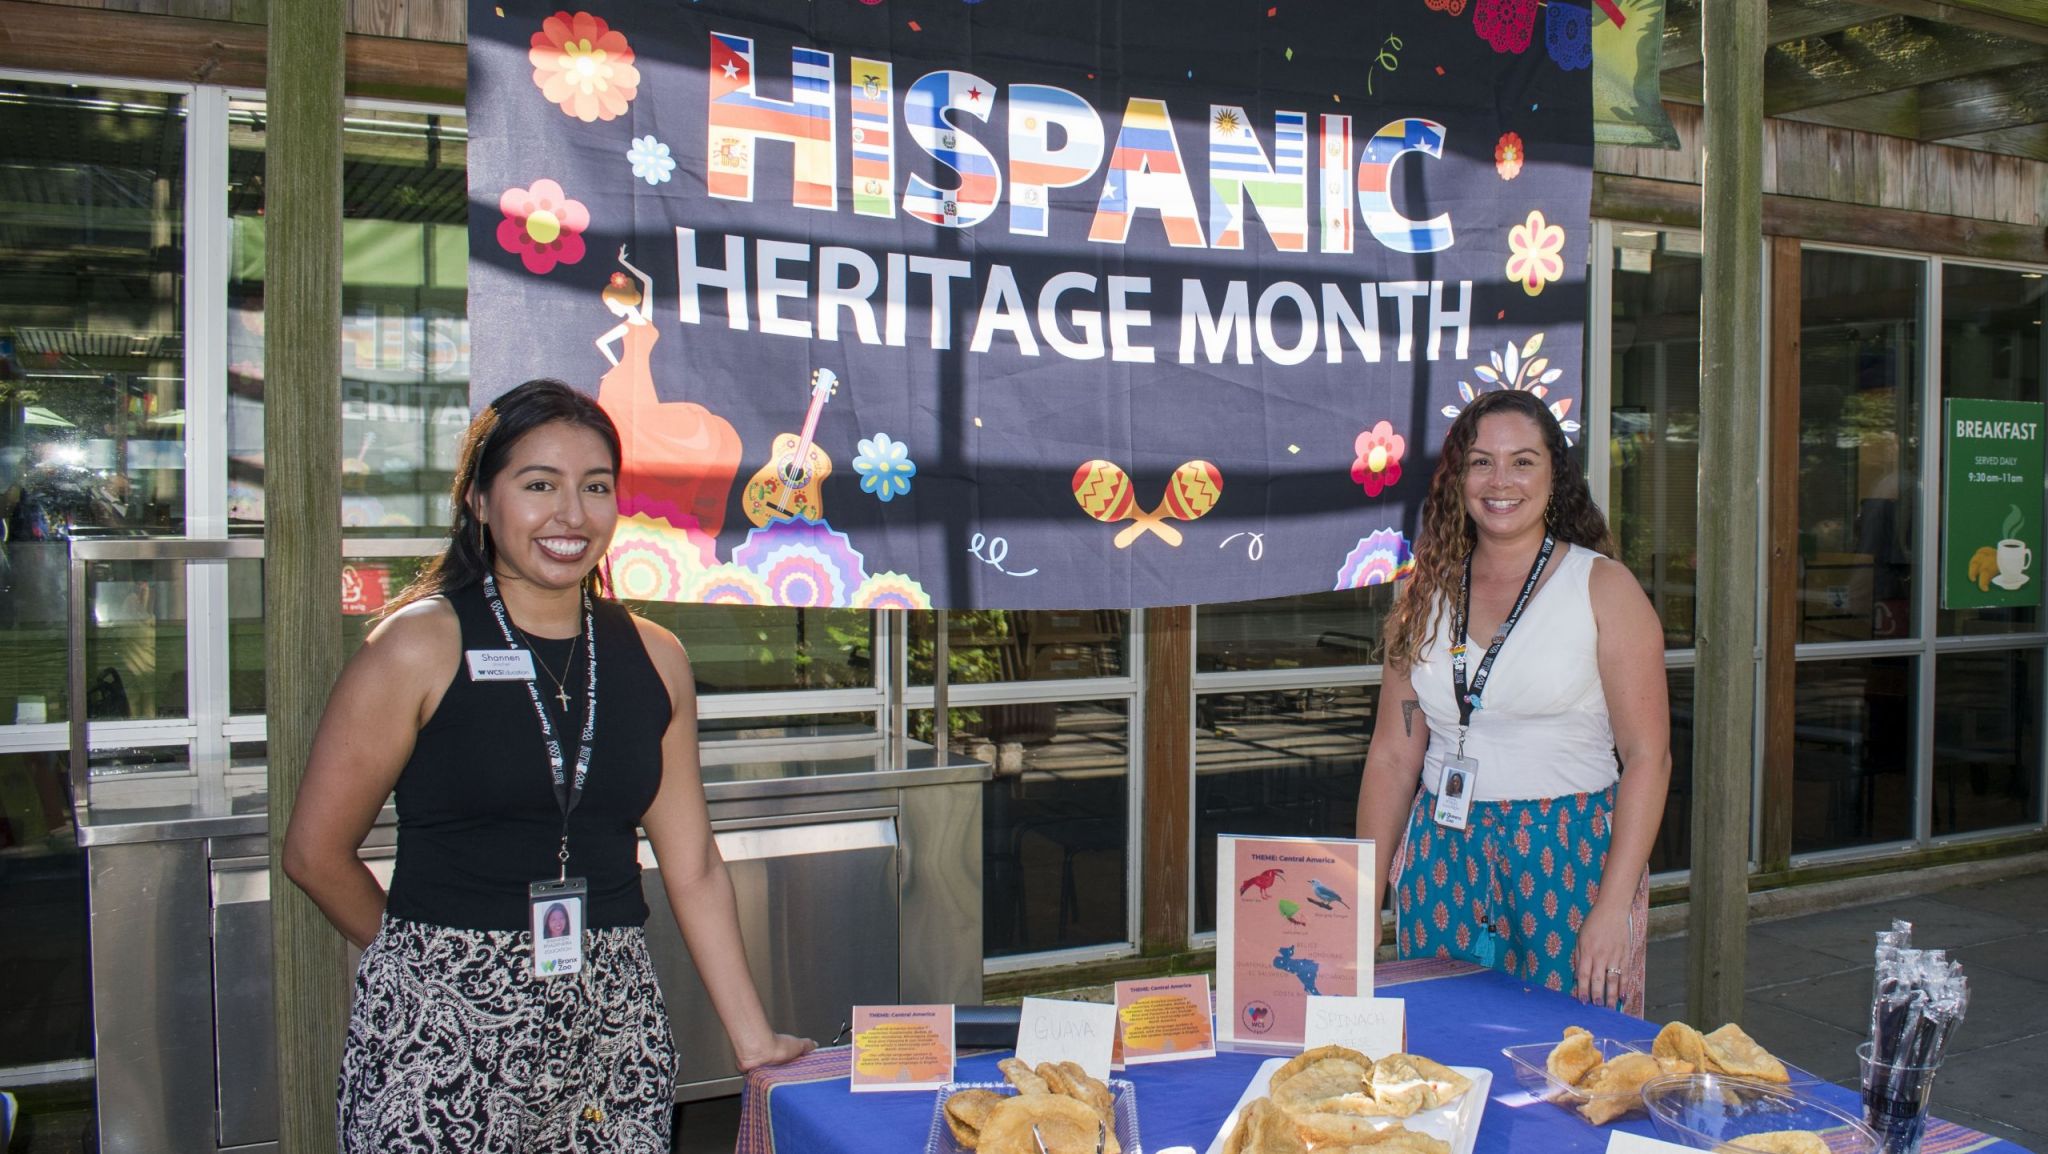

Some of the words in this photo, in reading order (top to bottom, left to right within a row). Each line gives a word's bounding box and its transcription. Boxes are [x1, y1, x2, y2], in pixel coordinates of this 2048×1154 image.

[708, 31, 1455, 254] HISPANIC
[676, 226, 1156, 364] HERITAGE
[1178, 280, 1473, 366] MONTH
[1956, 420, 2037, 440] BREAKFAST
[1975, 456, 1999, 466] SERVED
[2000, 457, 2018, 466] DAILY
[1531, 556, 1548, 580] Diversity
[481, 653, 521, 663] Shannen
[588, 642, 596, 660] Latin
[587, 660, 598, 690] Inspiring
[527, 682, 539, 700] Latin
[535, 701, 551, 736] Diversity
[1251, 854, 1278, 862] THEME:
[1279, 855, 1306, 864] Central
[1306, 856, 1336, 864] America
[1151, 984, 1170, 992] Central
[1034, 1015, 1096, 1041] GUAVA
